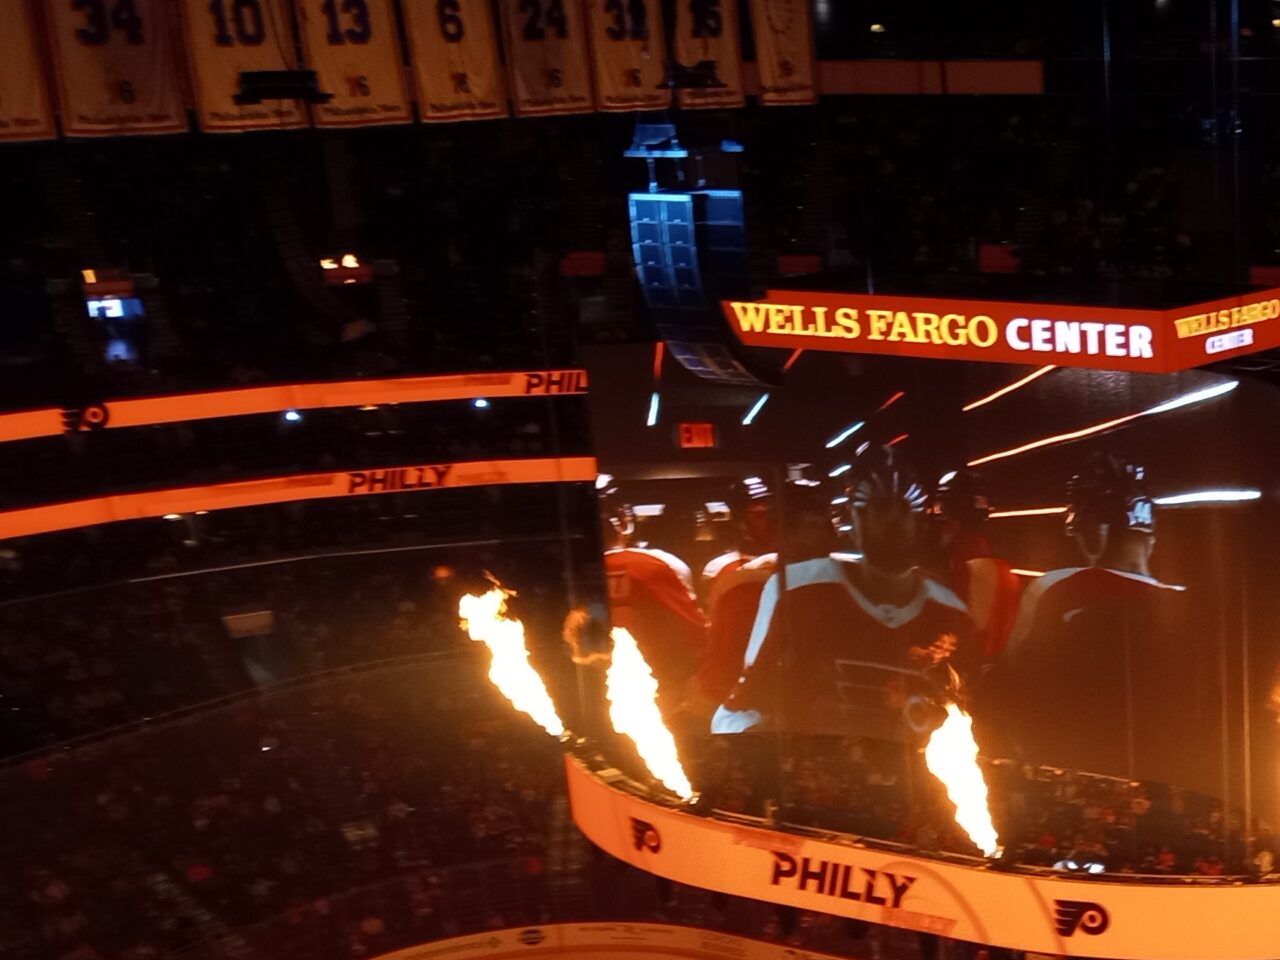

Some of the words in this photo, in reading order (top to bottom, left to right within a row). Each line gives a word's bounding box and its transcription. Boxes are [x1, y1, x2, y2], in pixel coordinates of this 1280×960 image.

[73, 0, 143, 45] 34
[210, 0, 265, 47] 10
[321, 0, 371, 45] 13
[437, 0, 464, 43] 6
[519, 0, 568, 41] 24
[731, 302, 861, 339] WELLS
[865, 309, 998, 348] FARGO
[1005, 317, 1153, 359] CENTER
[1175, 307, 1231, 339] WELLS
[1231, 299, 1280, 326] FARGO
[349, 465, 450, 494] PHILLY
[770, 850, 917, 909] PHILLY
